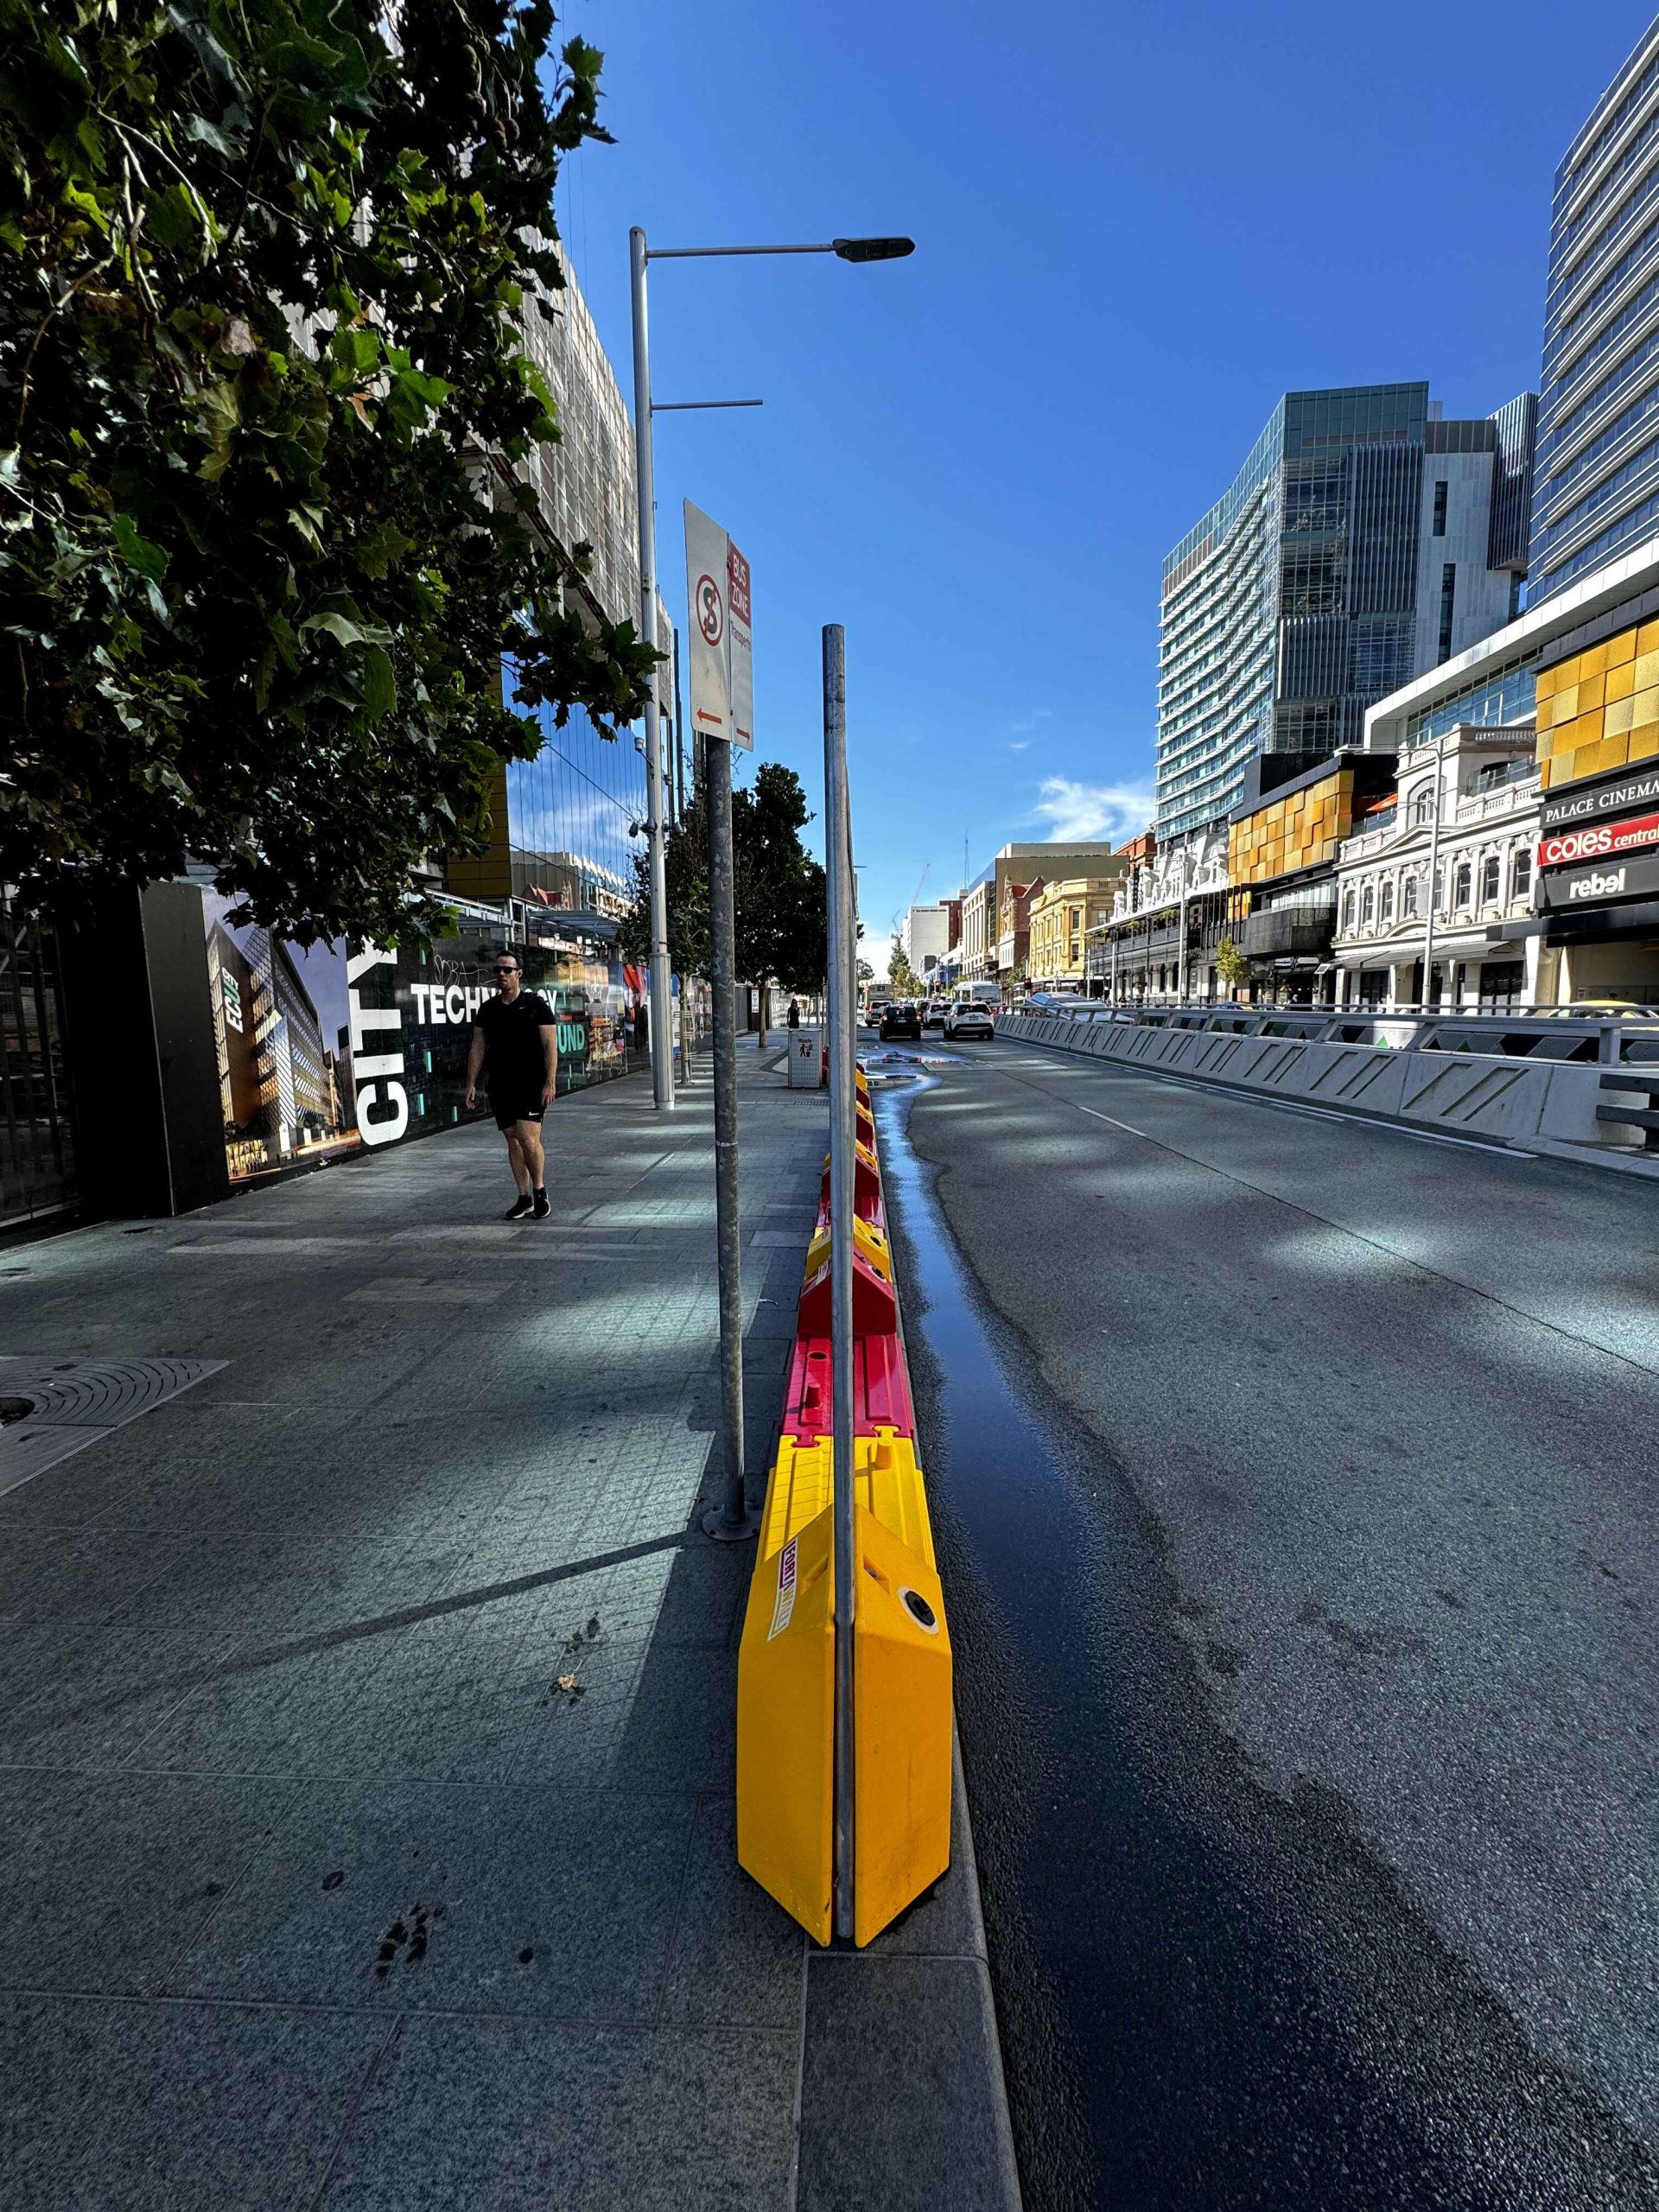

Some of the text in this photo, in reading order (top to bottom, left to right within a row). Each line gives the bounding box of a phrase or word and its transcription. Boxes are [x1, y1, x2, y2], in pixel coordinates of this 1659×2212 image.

[733, 553, 747, 588] BUS
[732, 581, 749, 619] ZONE
[1545, 798, 1595, 823] PALACE
[1546, 828, 1613, 862] coles
[1568, 868, 1626, 899] rebel
[224, 977, 244, 1033] ECU
[556, 1024, 585, 1054] UND
